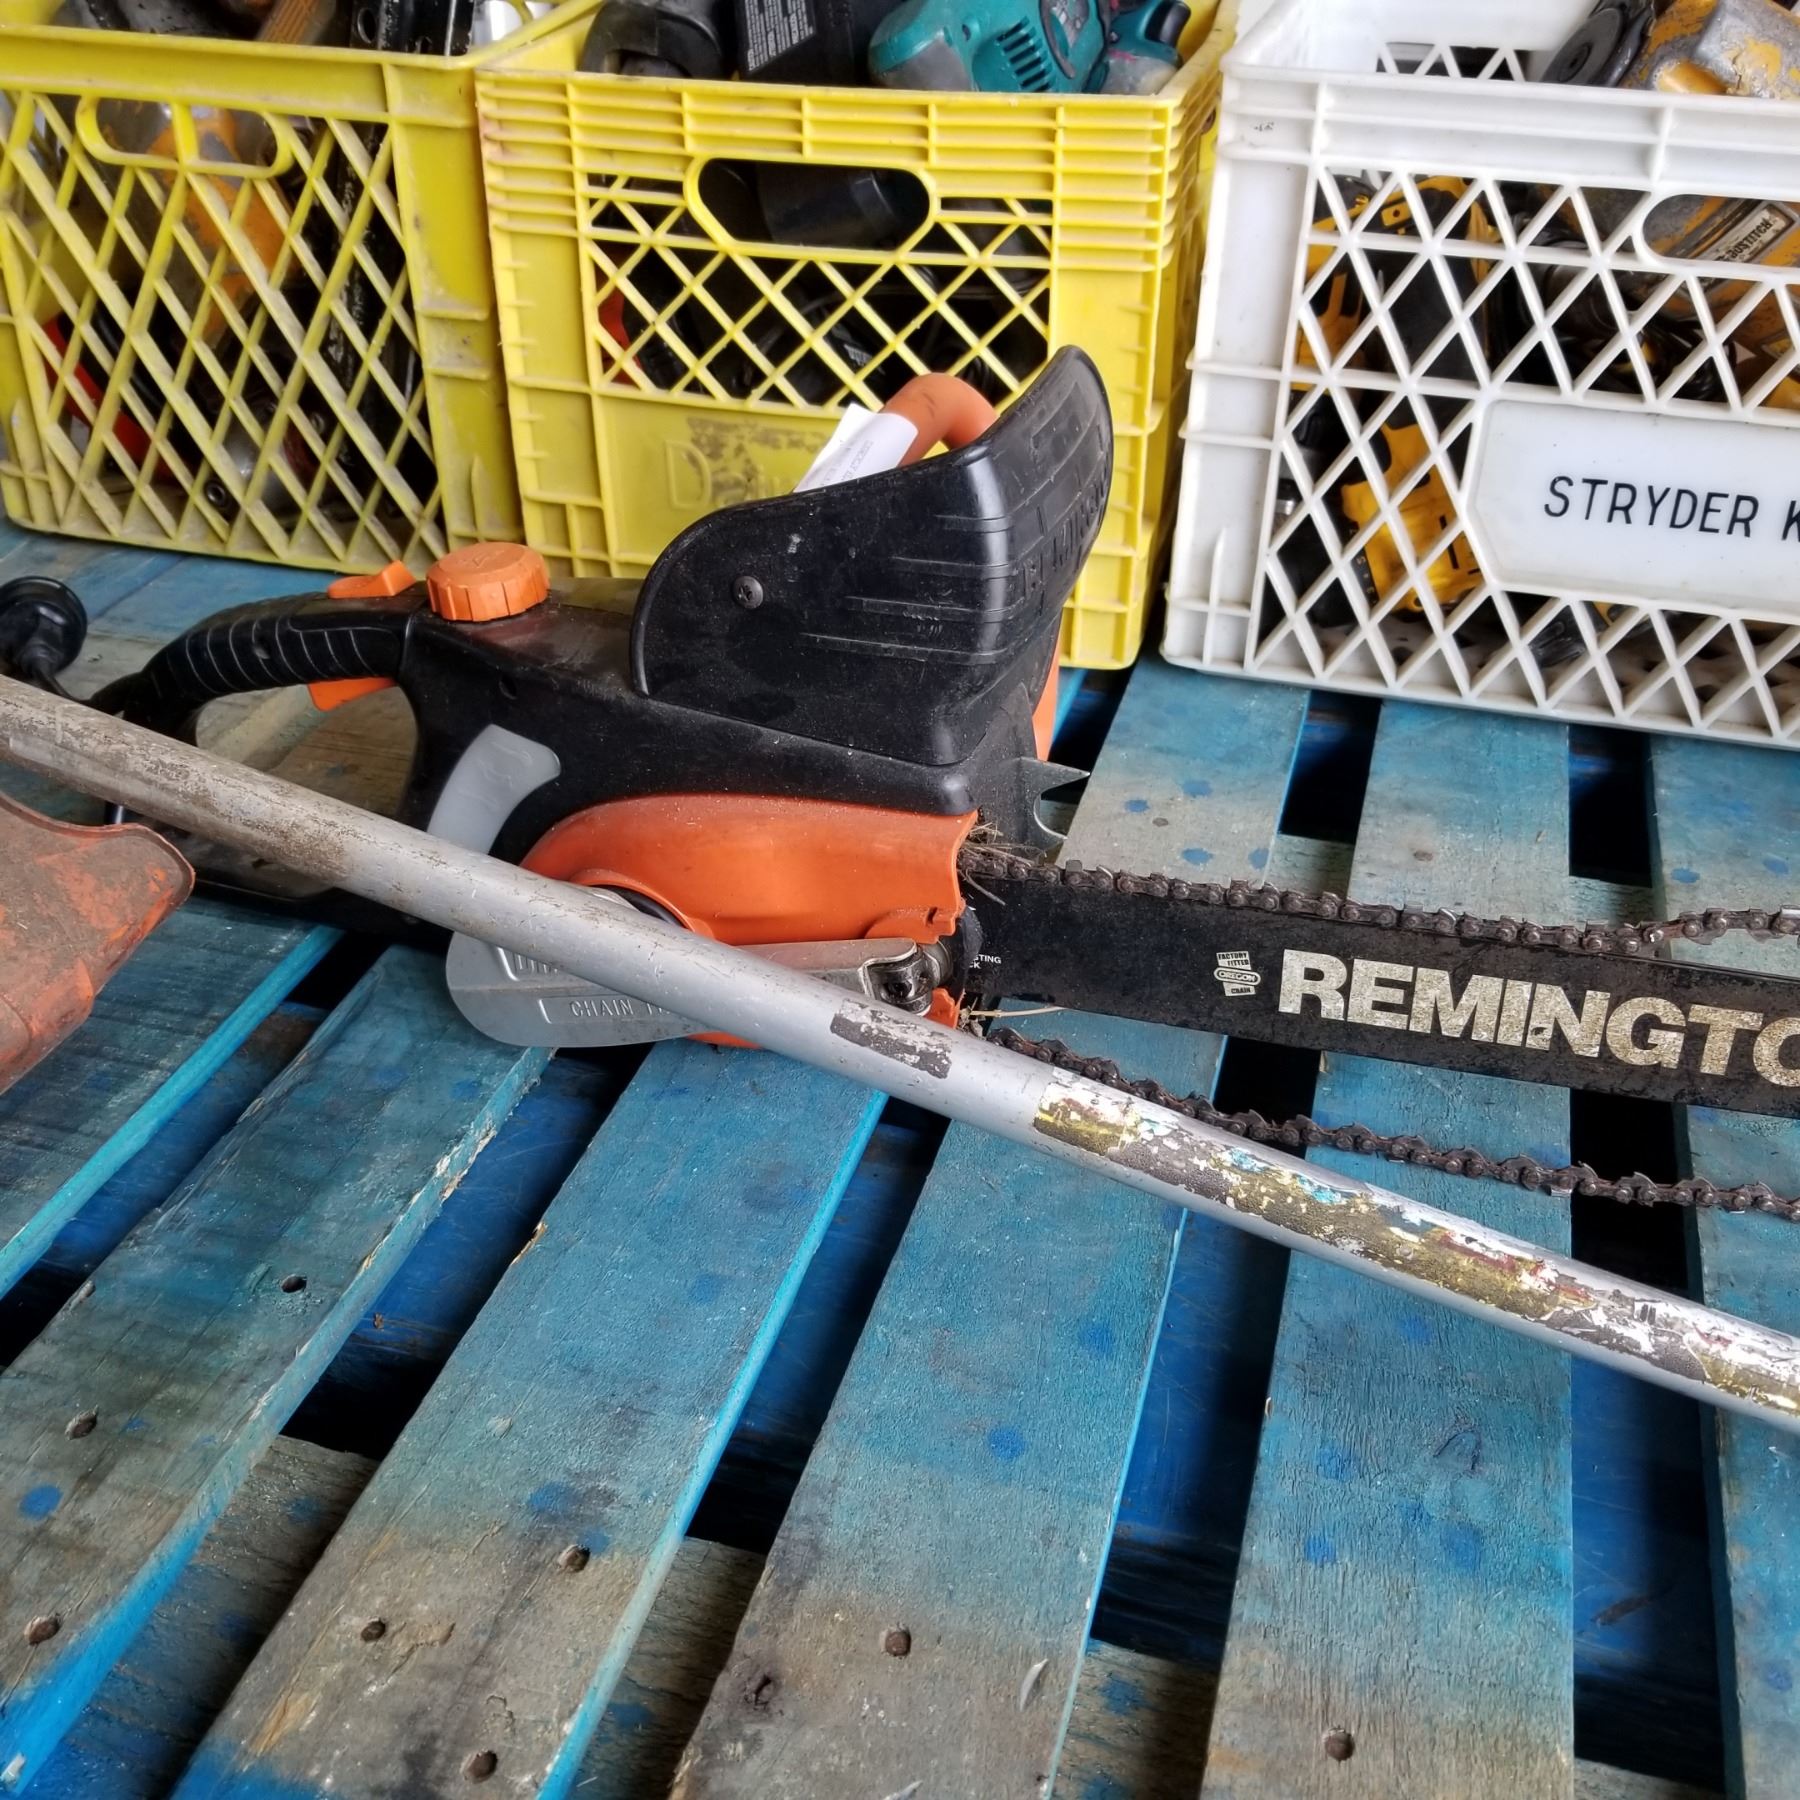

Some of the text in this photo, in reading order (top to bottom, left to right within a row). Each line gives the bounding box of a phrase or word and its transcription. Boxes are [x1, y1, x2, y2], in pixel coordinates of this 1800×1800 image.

[1544, 476, 1759, 537] STRYDER
[1217, 952, 1247, 960] FACTORY
[1218, 970, 1257, 983] OREGON
[570, 999, 634, 1018] CHAIN
